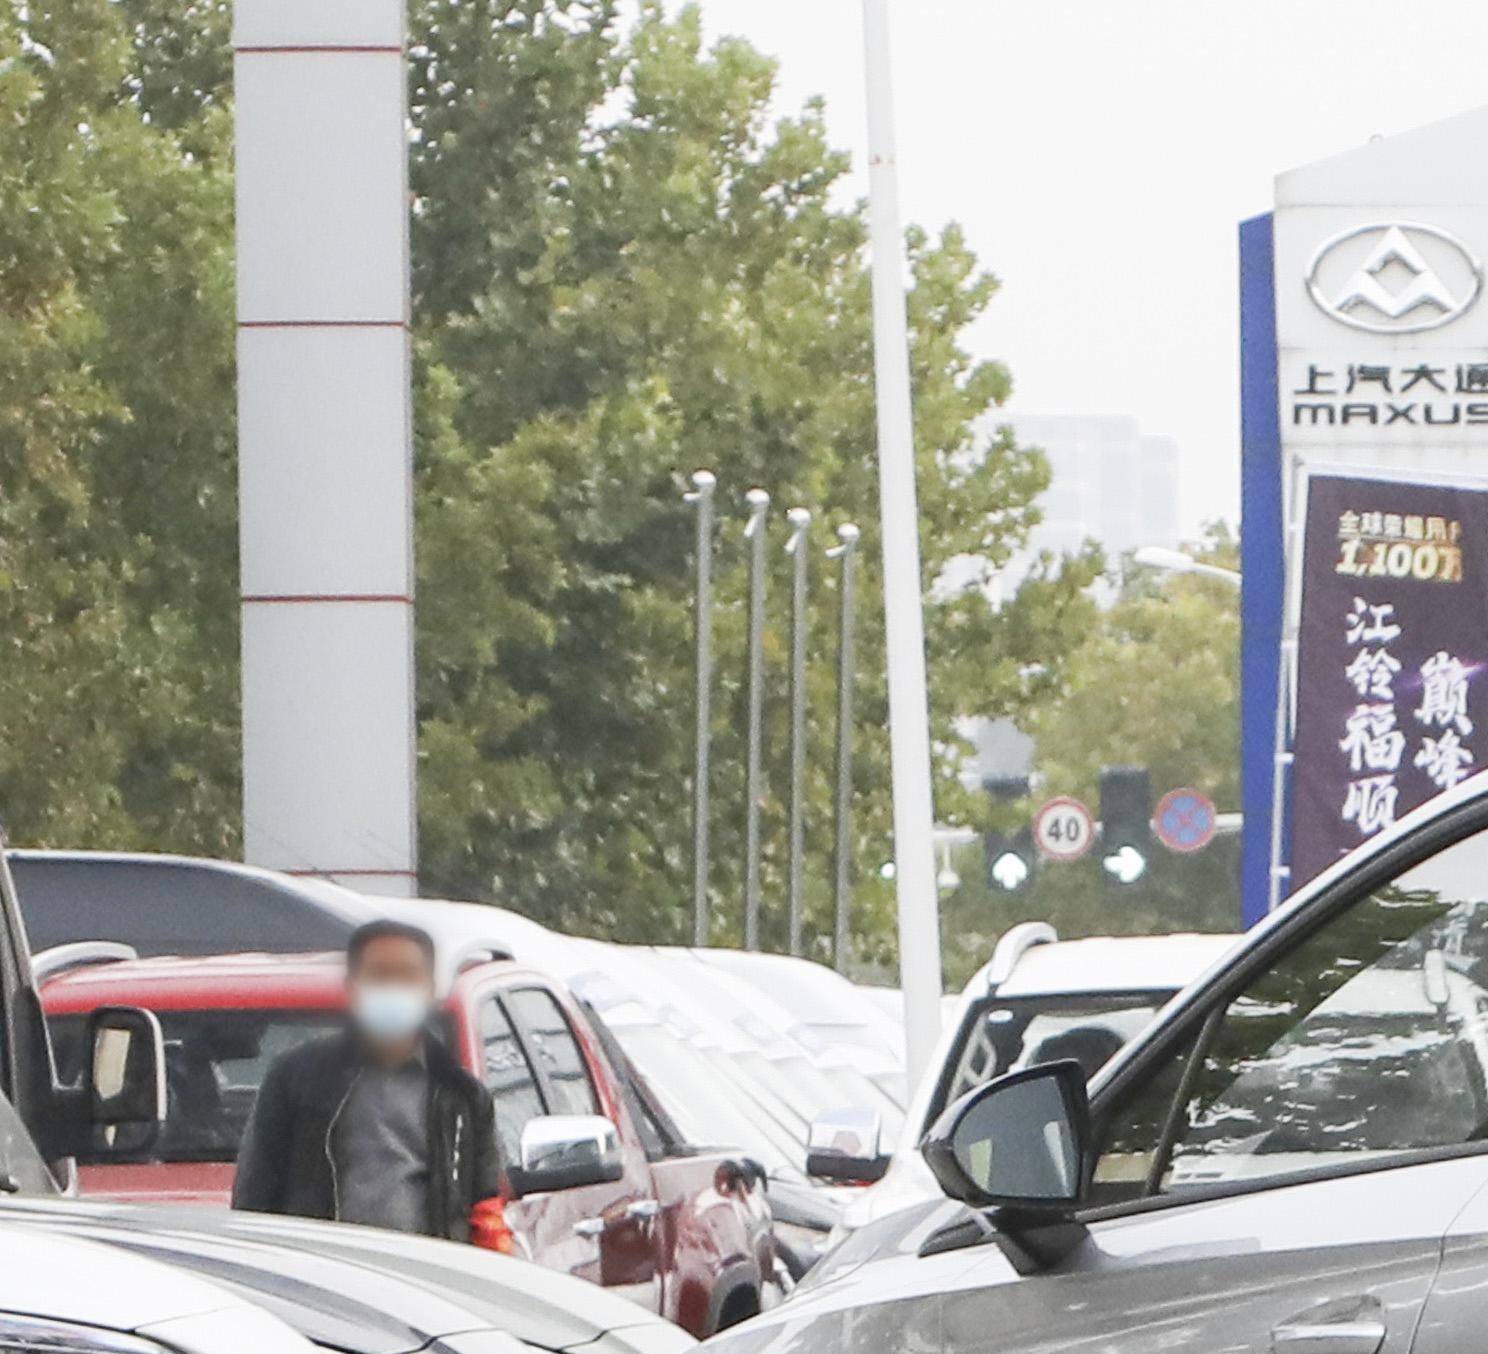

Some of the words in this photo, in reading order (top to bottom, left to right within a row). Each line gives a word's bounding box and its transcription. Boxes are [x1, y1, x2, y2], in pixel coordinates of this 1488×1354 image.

[1338, 597, 1406, 834] 江铃福顺
[1047, 816, 1080, 842] 40
